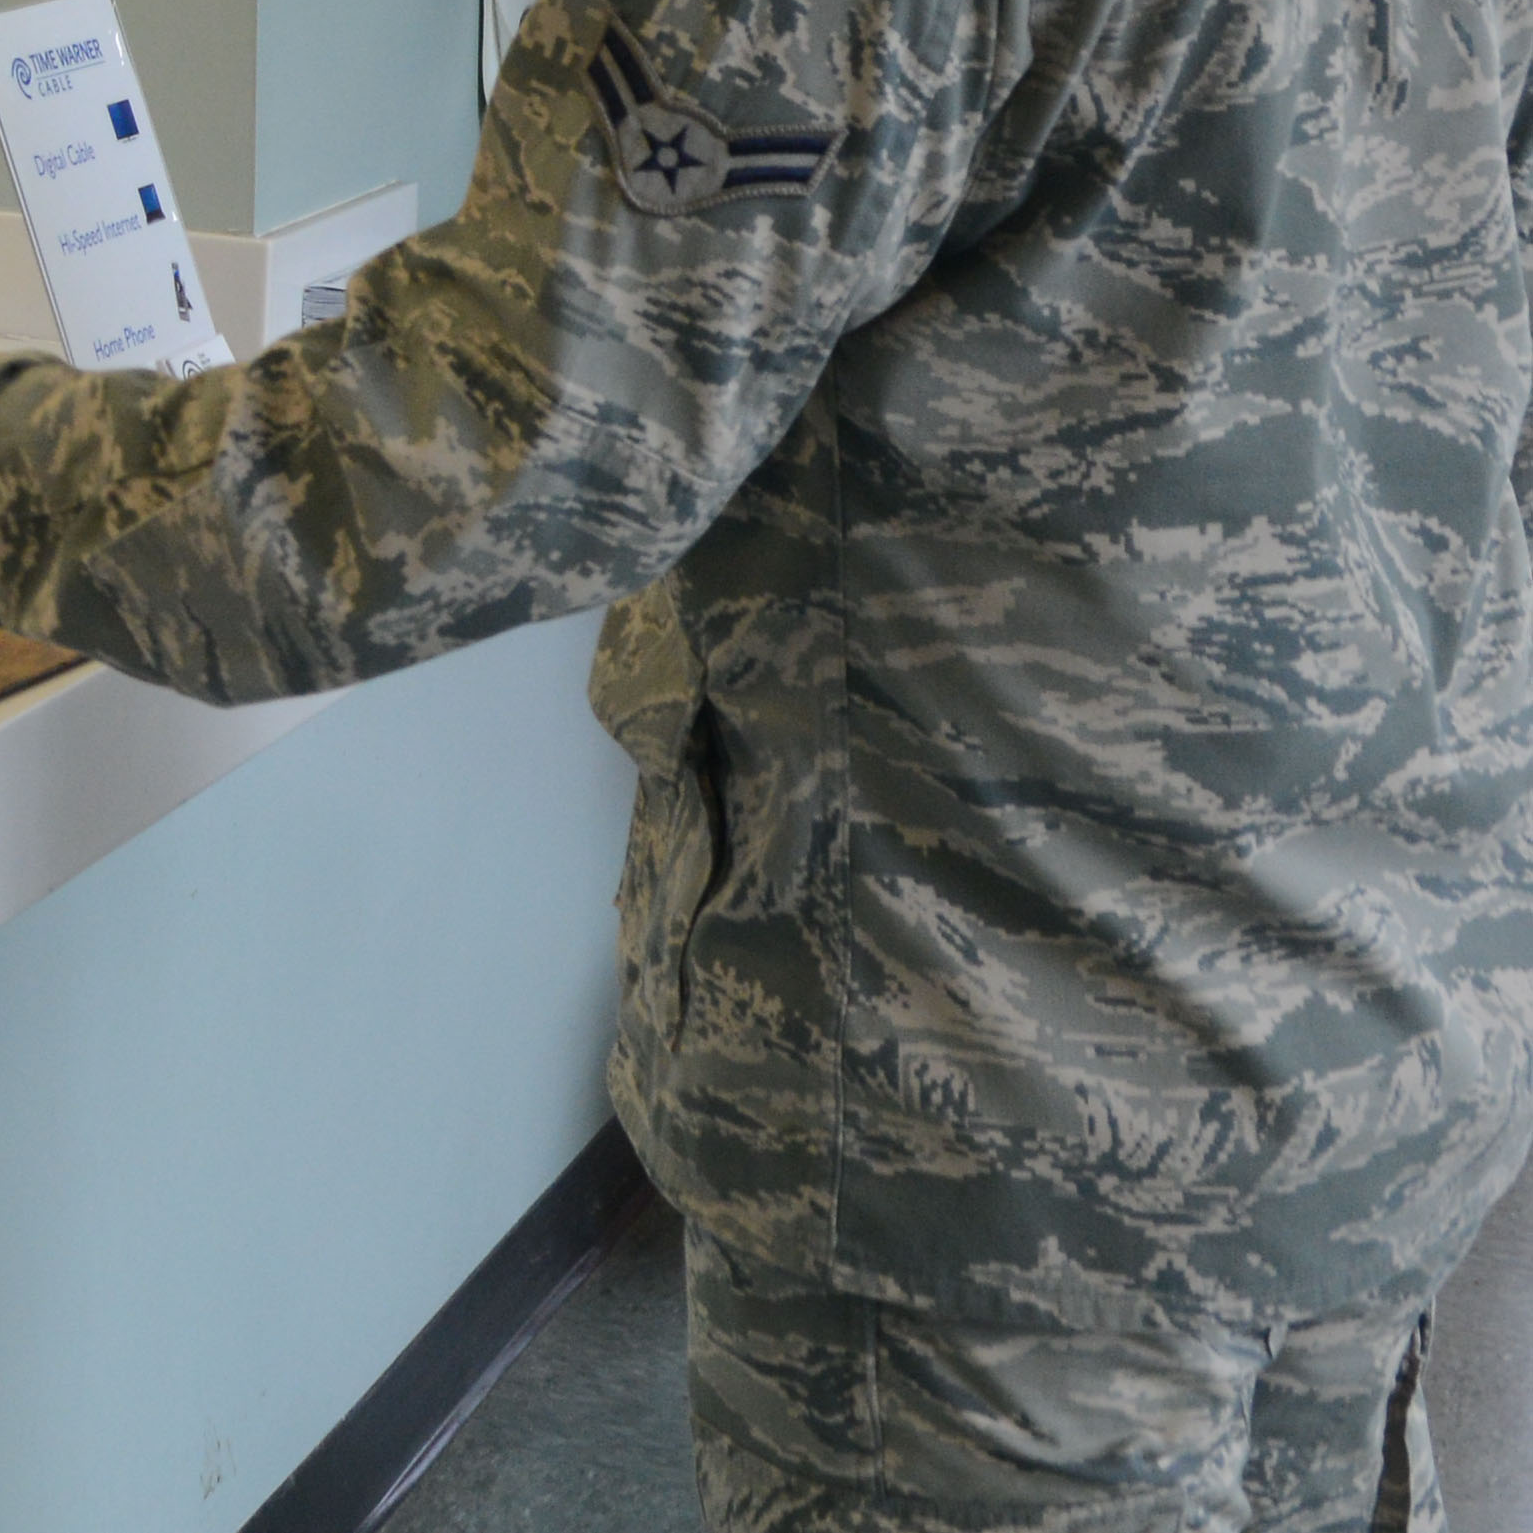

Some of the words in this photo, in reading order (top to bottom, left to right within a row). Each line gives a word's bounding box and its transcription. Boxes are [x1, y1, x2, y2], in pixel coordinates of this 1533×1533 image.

[29, 49, 58, 74] TIME
[56, 38, 103, 68] WARNER
[38, 74, 73, 97] CABLE
[34, 148, 67, 179] Digital
[66, 141, 96, 166] Cable
[58, 223, 104, 256] Hi-Speed
[101, 214, 142, 241] Internet
[93, 336, 125, 362] Home
[123, 324, 156, 349] Phone
